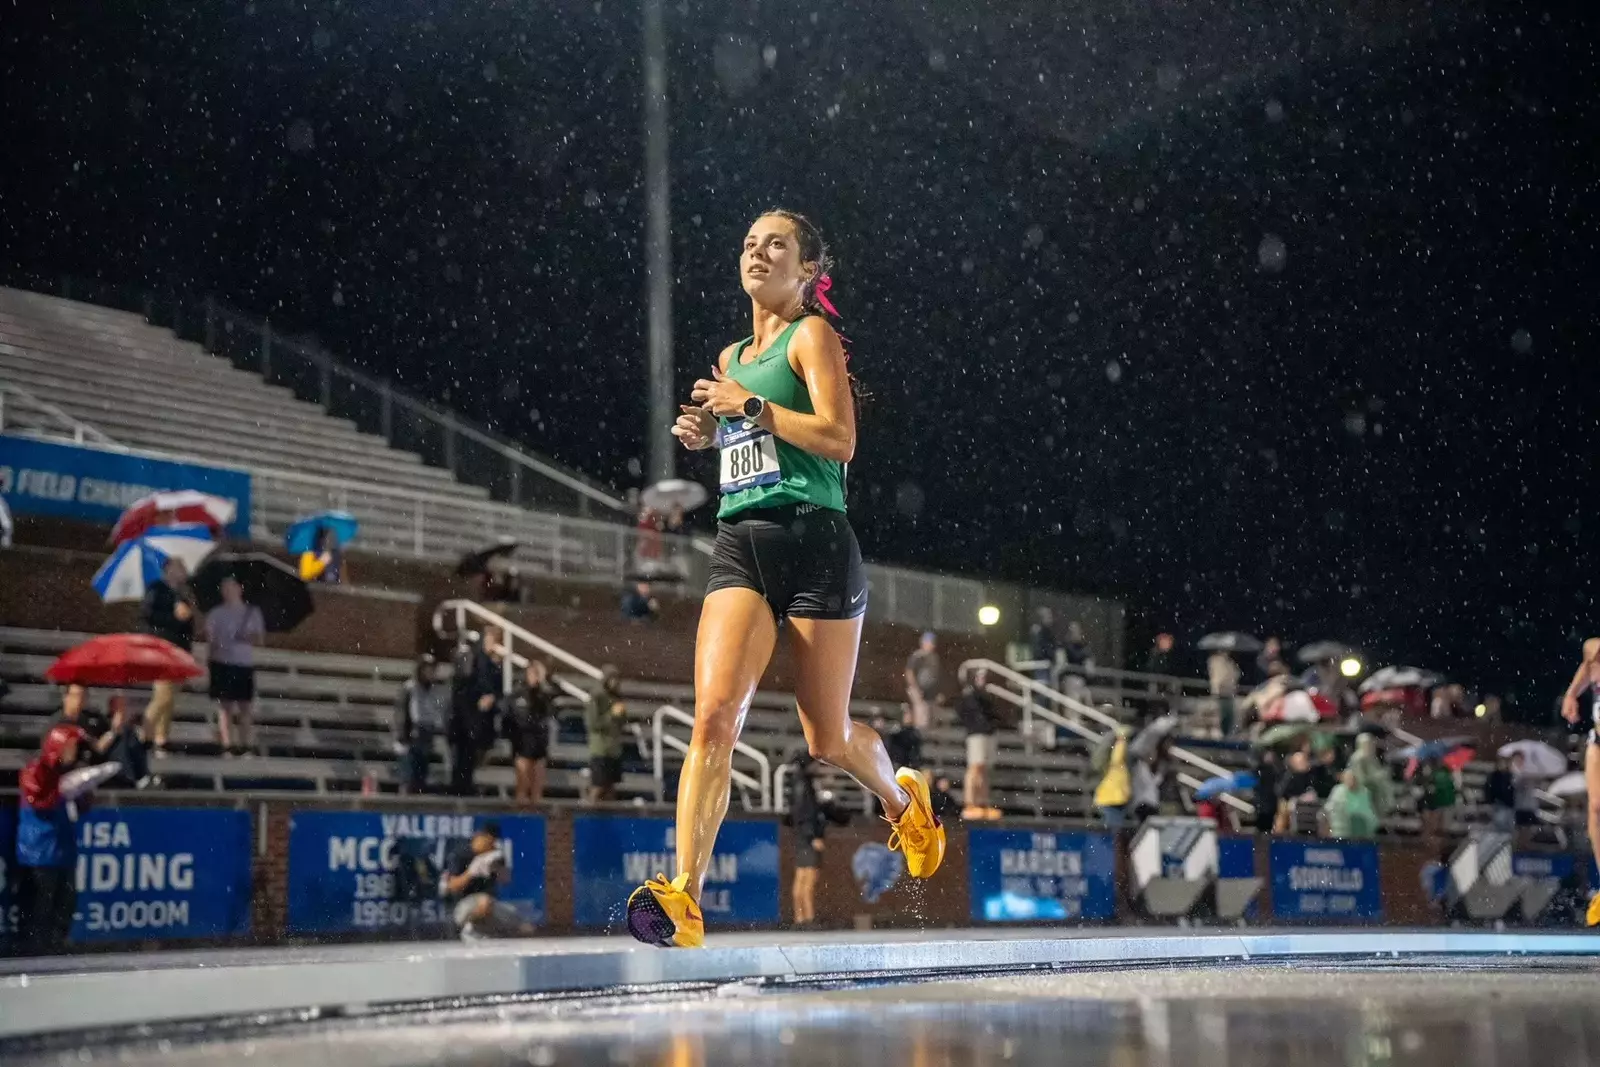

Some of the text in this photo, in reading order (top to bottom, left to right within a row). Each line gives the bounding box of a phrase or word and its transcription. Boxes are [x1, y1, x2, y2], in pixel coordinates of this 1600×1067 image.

[731, 441, 764, 479] 880
[796, 503, 823, 515] NIK
[77, 821, 130, 848] ISA
[381, 814, 475, 837] VALERIE
[75, 852, 194, 892] IDING
[86, 899, 190, 933] 3,000M
